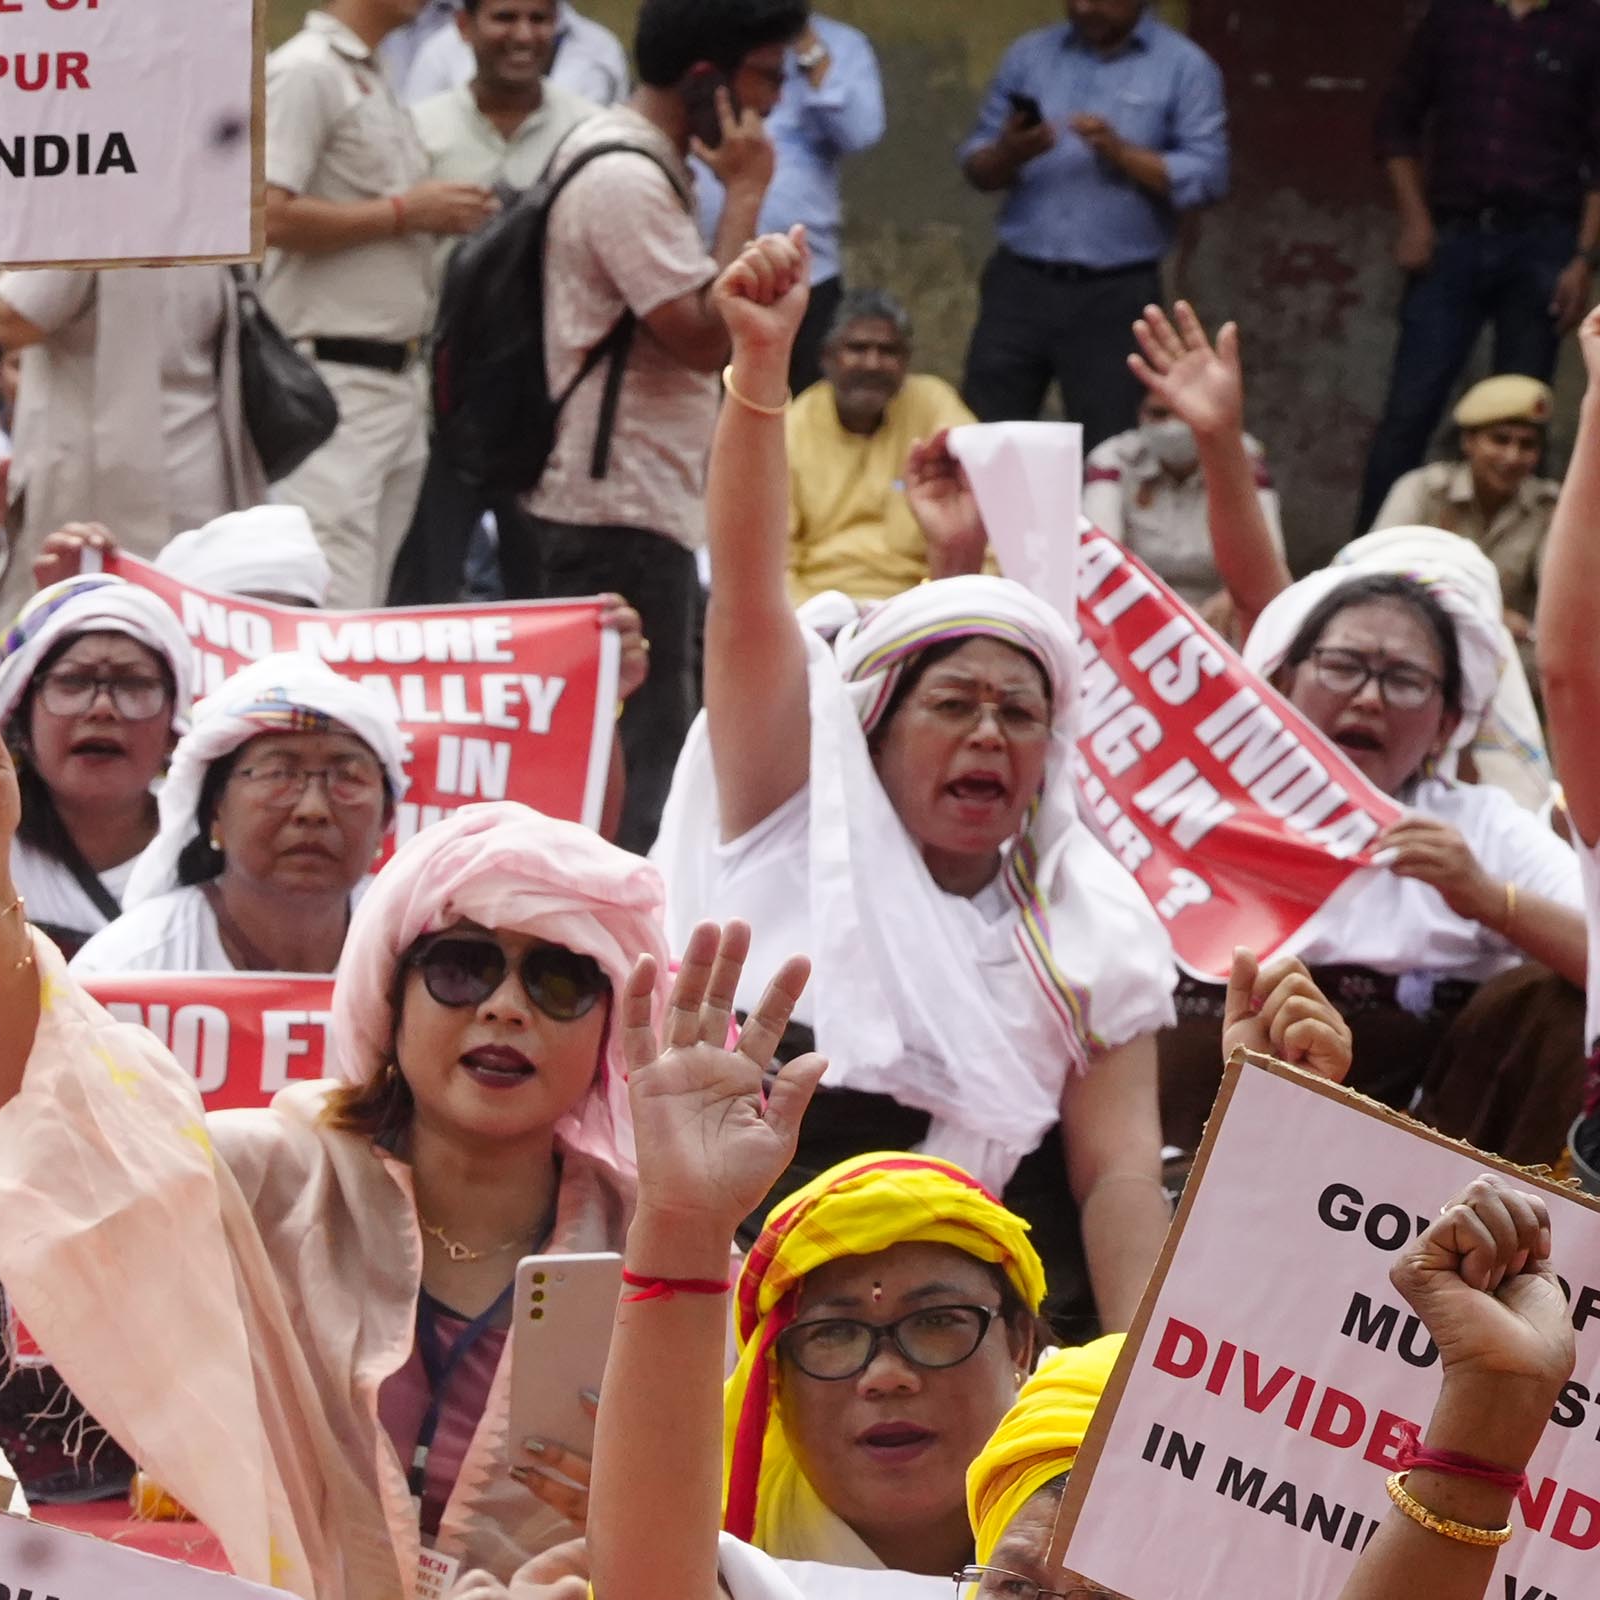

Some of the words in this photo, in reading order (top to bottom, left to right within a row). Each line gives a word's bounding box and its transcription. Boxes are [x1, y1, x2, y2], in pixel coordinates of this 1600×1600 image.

[181, 590, 274, 662] NO
[297, 615, 514, 665] MORE
[1129, 615, 1227, 706] IS
[436, 735, 511, 799] IN
[1132, 757, 1237, 850] IN
[1152, 1317, 1418, 1471] DIVIDE
[1141, 1423, 1205, 1481] IN
[1216, 1456, 1380, 1557] MANI
